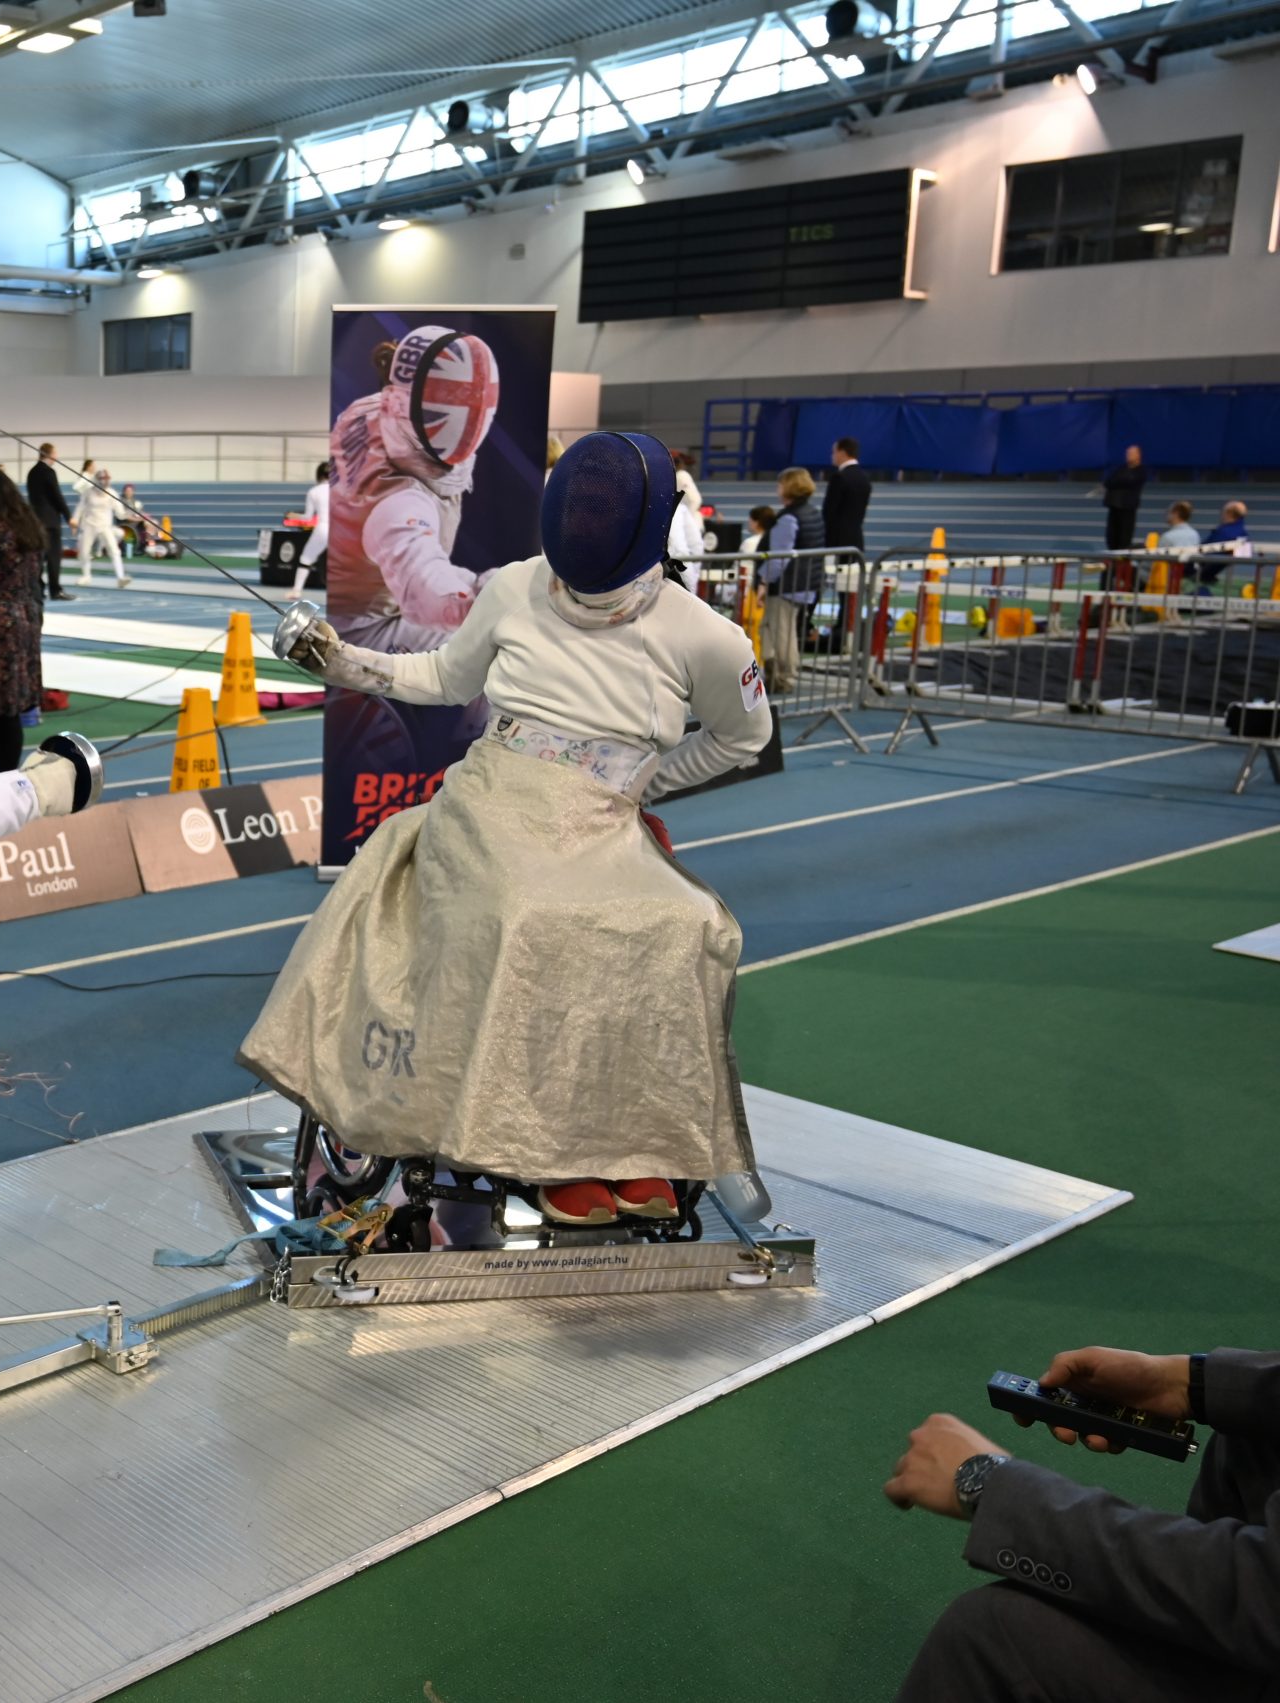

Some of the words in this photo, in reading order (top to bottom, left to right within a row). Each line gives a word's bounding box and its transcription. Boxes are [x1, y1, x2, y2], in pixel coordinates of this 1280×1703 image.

[394, 335, 433, 384] GBR
[193, 759, 216, 773] FIELD
[214, 807, 299, 845] Leon
[26, 875, 78, 898] London
[484, 1259, 513, 1269] made
[517, 1259, 529, 1270] by
[531, 1255, 628, 1268] www.pallagiart.hu
